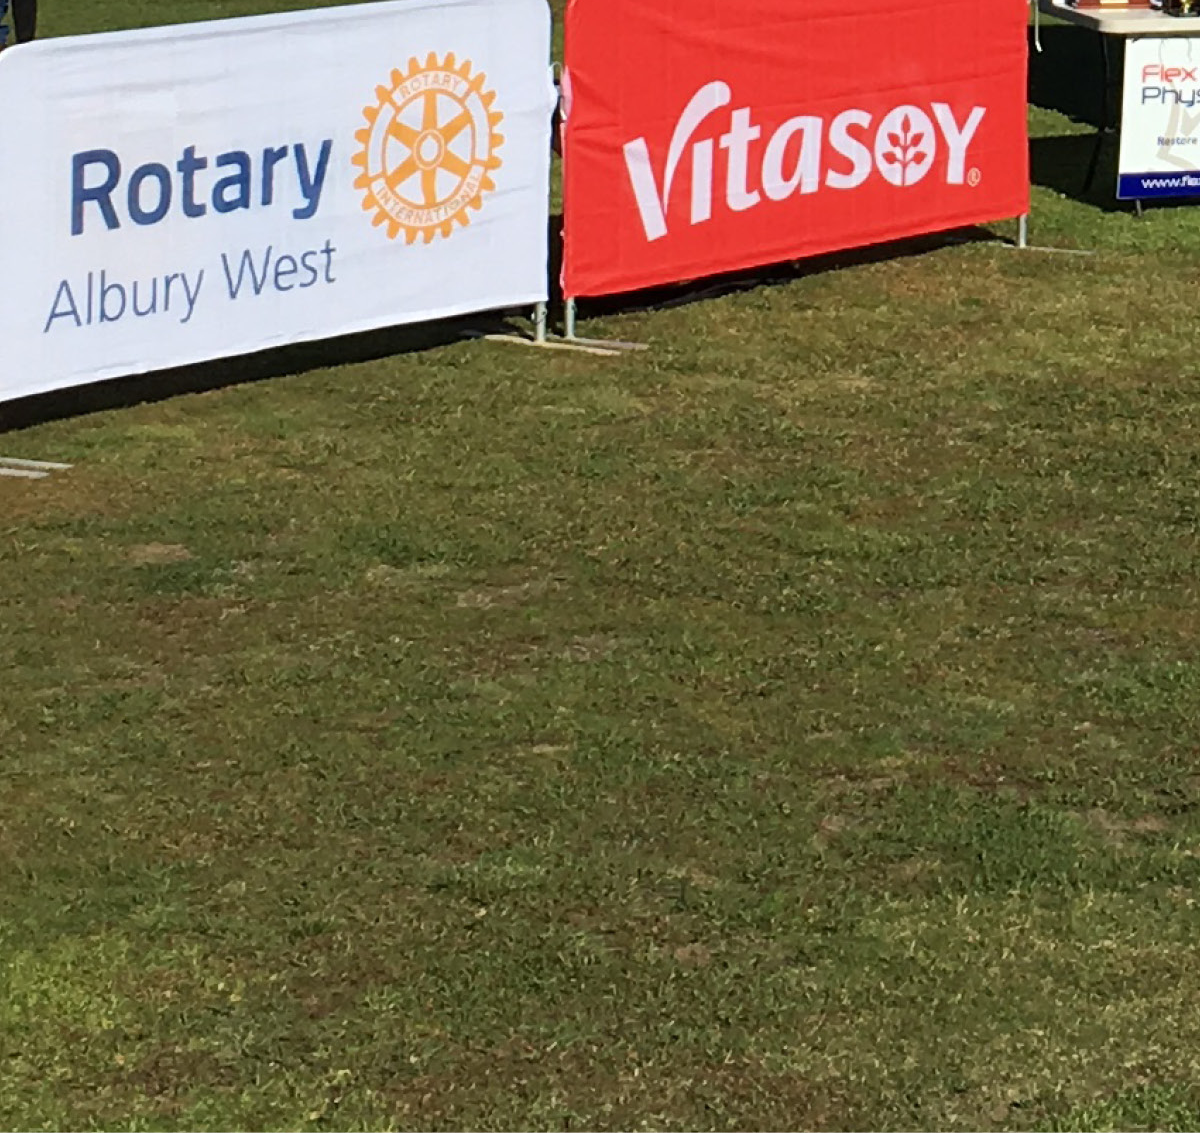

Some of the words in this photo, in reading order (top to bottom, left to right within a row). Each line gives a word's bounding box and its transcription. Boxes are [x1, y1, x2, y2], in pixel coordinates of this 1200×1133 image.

[398, 73, 463, 100] ROTARY
[1142, 64, 1198, 83] Flex
[71, 138, 333, 237] Rotary
[375, 172, 481, 224] INTERNATIONAL
[43, 268, 204, 334] Albury
[220, 239, 338, 300] West
